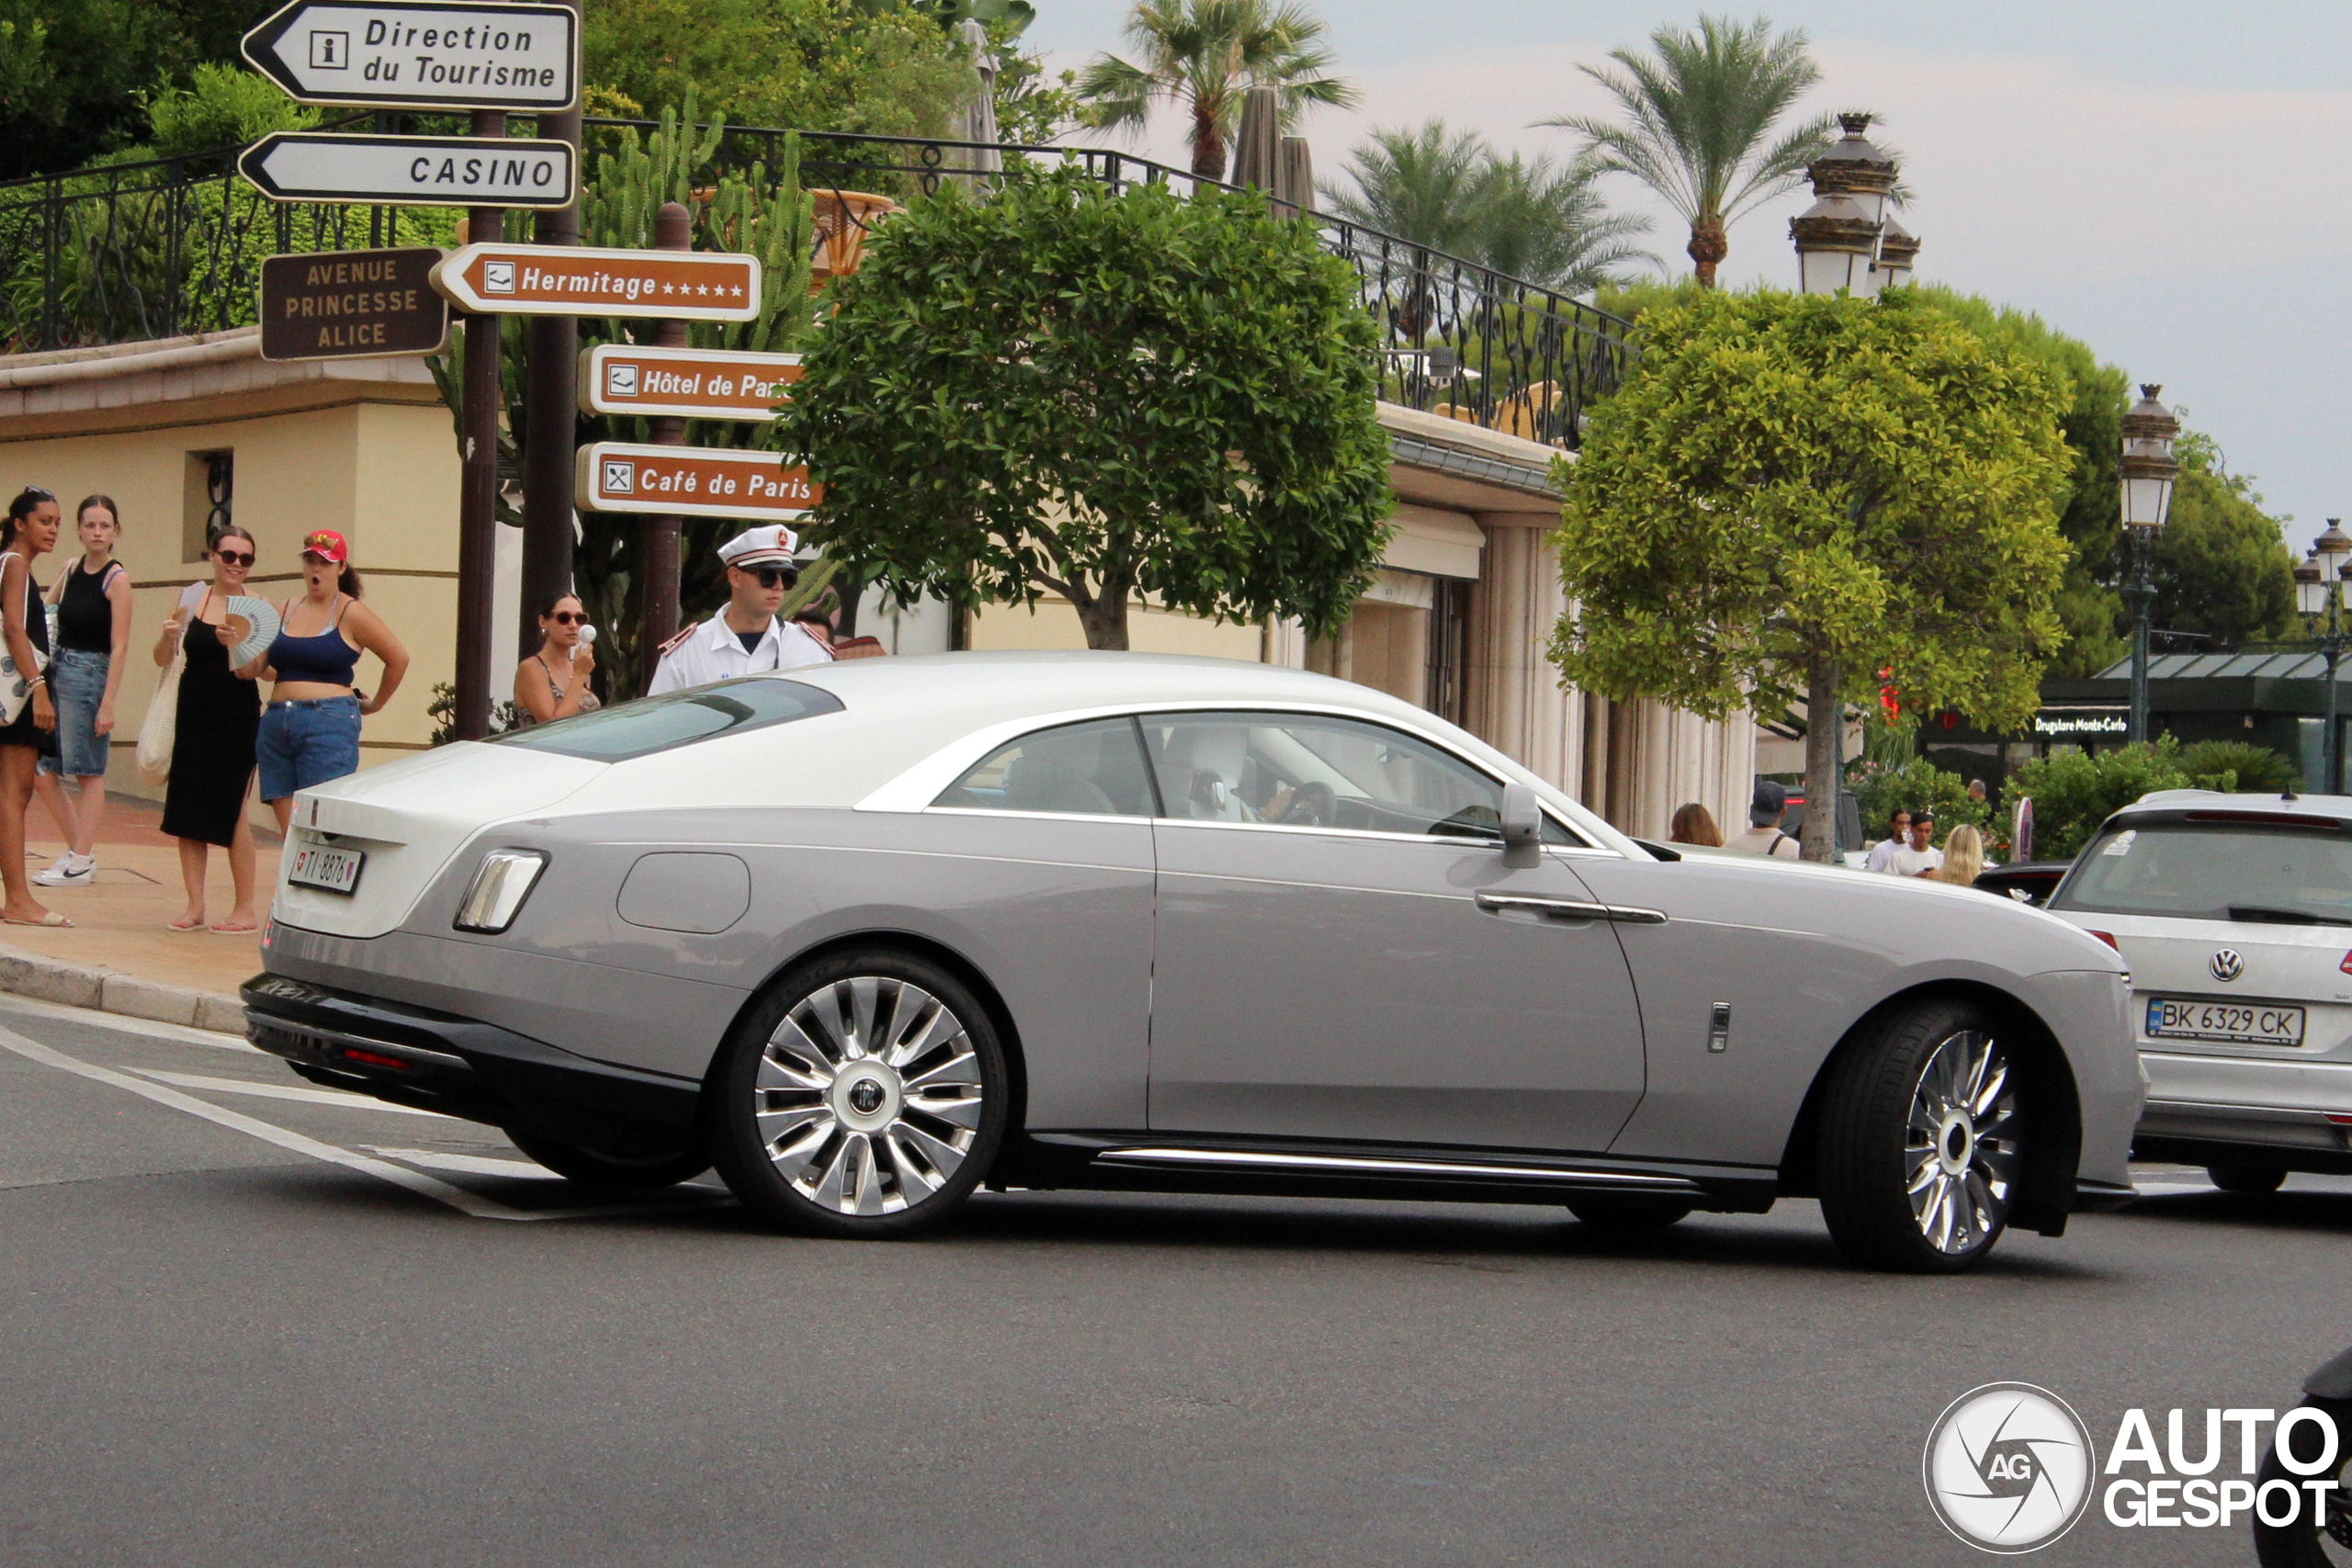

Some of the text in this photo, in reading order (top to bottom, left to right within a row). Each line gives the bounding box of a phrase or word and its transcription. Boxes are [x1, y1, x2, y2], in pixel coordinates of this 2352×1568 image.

[365, 19, 531, 51] Direction
[364, 56, 555, 86] du Tourisme
[410, 157, 552, 186] CASINO
[307, 260, 396, 286] AVENUE
[522, 267, 655, 300] Hermitage
[286, 289, 417, 318] PRINCESSE
[318, 323, 385, 347] ALICE
[643, 370, 701, 396] Hôtel
[707, 375, 733, 396] de
[641, 468, 810, 499] Café de Paris
[2035, 716, 2127, 735] Drugstore Monte-Carlo
[2162, 1004, 2294, 1035] BK 6329 CK
